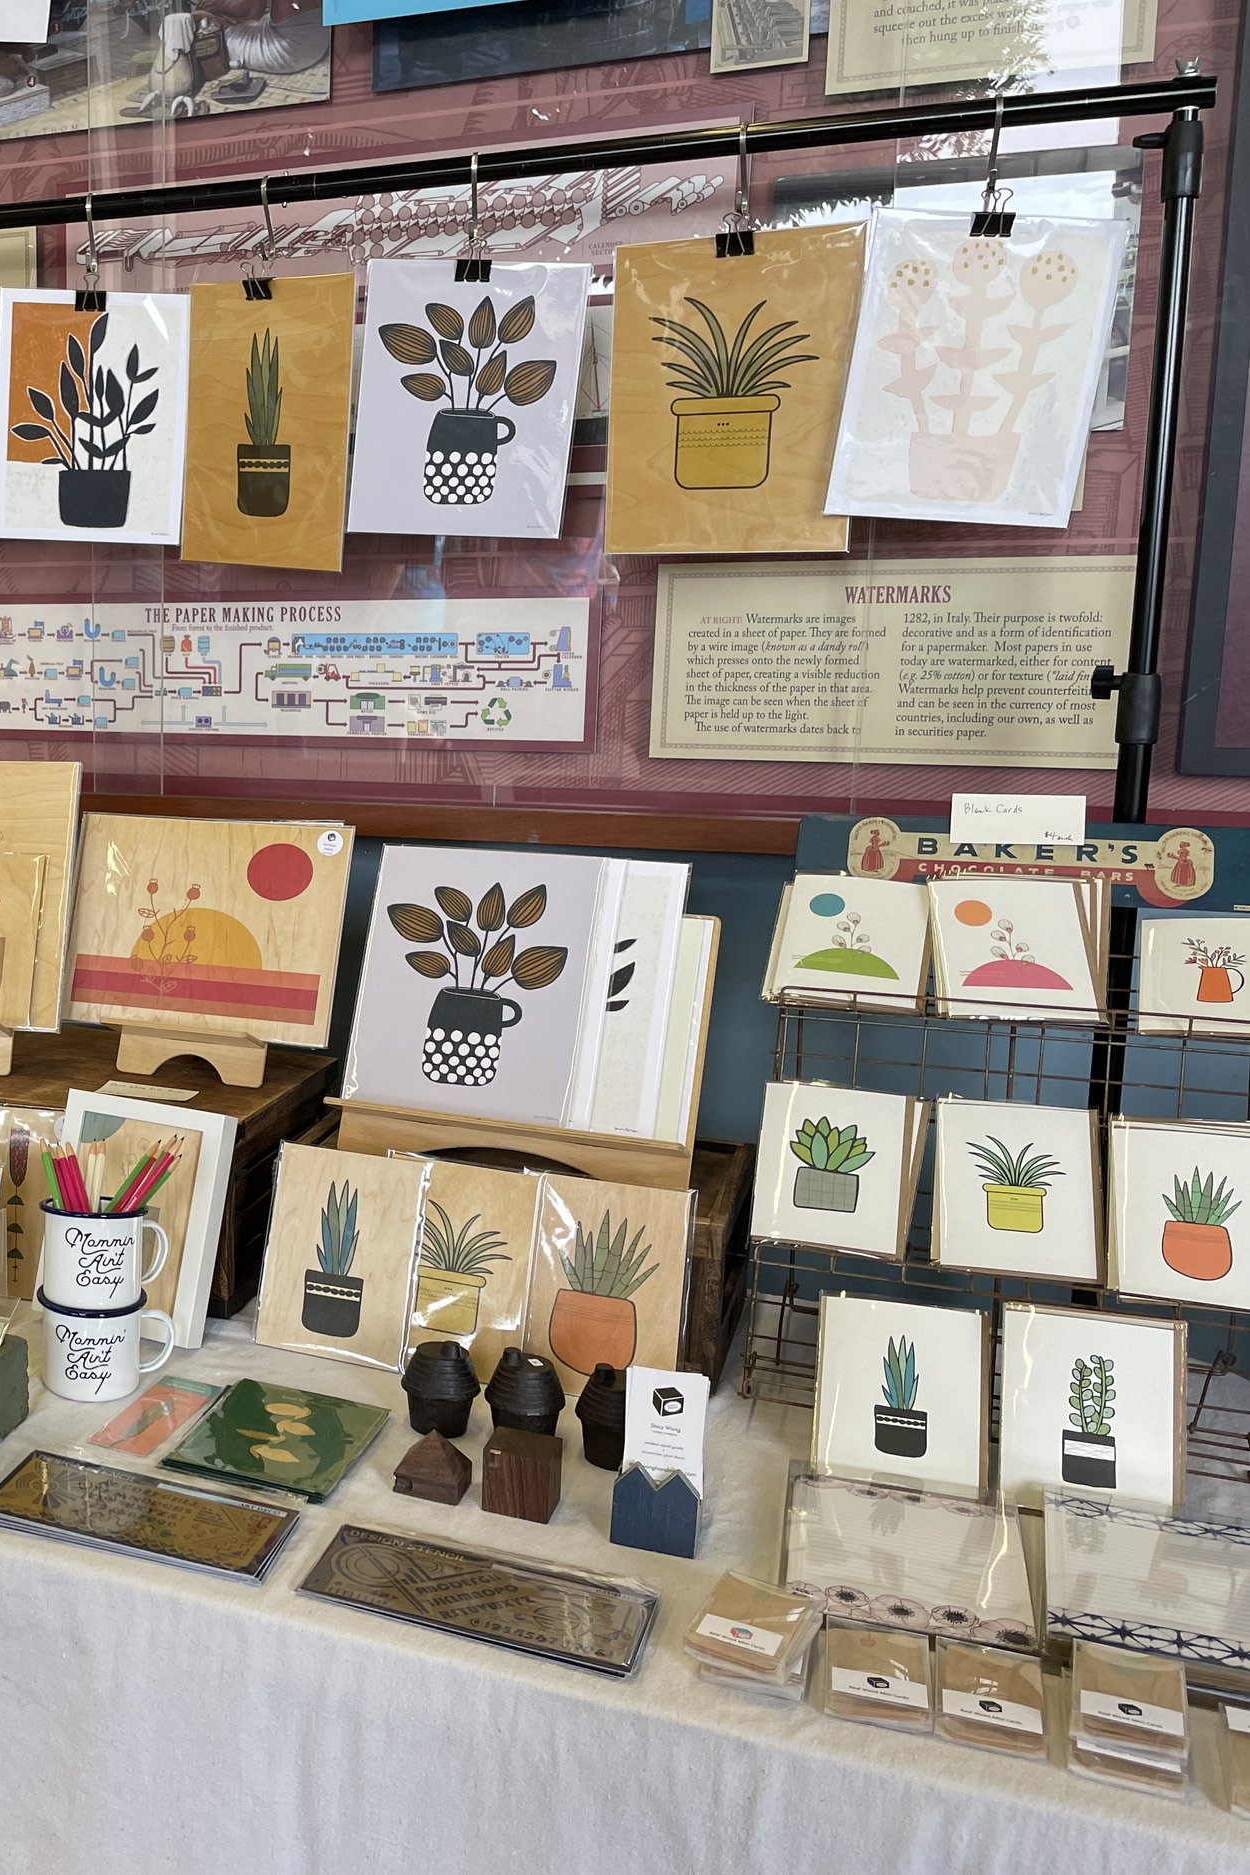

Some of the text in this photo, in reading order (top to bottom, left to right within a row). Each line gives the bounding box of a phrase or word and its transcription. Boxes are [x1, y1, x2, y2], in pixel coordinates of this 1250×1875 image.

[929, 30, 958, 43] hung
[960, 29, 975, 42] up
[978, 25, 990, 36] to
[992, 21, 1026, 36] finish
[42, 124, 79, 134] THOM
[845, 585, 952, 604] WATERMARKS
[144, 605, 341, 624] THE PAPER MAKING PROCESS
[904, 612, 930, 624] 1282,
[933, 615, 943, 623] in
[946, 611, 971, 626] Italy.
[972, 610, 1001, 622] Their
[1003, 615, 1044, 626] purpose
[1059, 610, 1102, 622] twofold:
[171, 623, 187, 631] From
[188, 623, 205, 631] forest
[213, 623, 223, 631] the
[224, 623, 248, 631] finished
[248, 622, 273, 633] product.
[901, 626, 952, 637] decorative
[955, 626, 974, 637] and
[999, 625, 1024, 637] form
[1027, 625, 1040, 637] of
[1042, 625, 1111, 637] identification
[901, 640, 916, 651] for
[926, 640, 988, 655] papermaker.
[993, 640, 1022, 652] Most
[1024, 644, 1058, 655] papers
[1075, 644, 1092, 652] use
[900, 654, 927, 669] today
[947, 654, 1017, 667] watermarked,
[1019, 655, 1050, 666] either
[1052, 654, 1068, 666] for
[898, 668, 917, 684] (e.g.
[919, 669, 941, 680] 25%
[943, 668, 975, 682] cotton)
[977, 672, 989, 680] or
[991, 668, 1006, 680] for
[1008, 672, 1043, 680] texture
[898, 682, 958, 694] Watermarks
[961, 683, 983, 698] help
[986, 686, 1025, 698] prevent
[896, 697, 915, 708] and
[917, 700, 934, 708] can
[937, 697, 949, 708] be
[977, 701, 986, 709] in
[990, 698, 1006, 709] the
[1009, 702, 1053, 713] currency
[1055, 698, 1069, 710] of
[1070, 702, 1096, 710] most
[895, 714, 943, 723] countries,
[946, 711, 994, 726] including
[1017, 716, 1042, 725] own,
[1045, 716, 1055, 724] as
[1058, 713, 1079, 724] well
[907, 728, 953, 736] securities
[955, 729, 986, 740] paper.
[964, 803, 1022, 814] Blank Cards
[917, 838, 1138, 864] BAKER'S
[1081, 870, 1134, 881] BARS
[78, 1248, 125, 1274] Ain't
[76, 1269, 124, 1299] Easy
[67, 1346, 112, 1370] Ain't
[65, 1365, 112, 1395] Easy
[651, 1422, 681, 1433] Stacy Wong
[350, 1530, 467, 1562] DESIGN STENCIL
[750, 1641, 765, 1650] Cards
[1006, 1717, 1023, 1725] Cards
[1145, 1720, 1163, 1728] Cards
